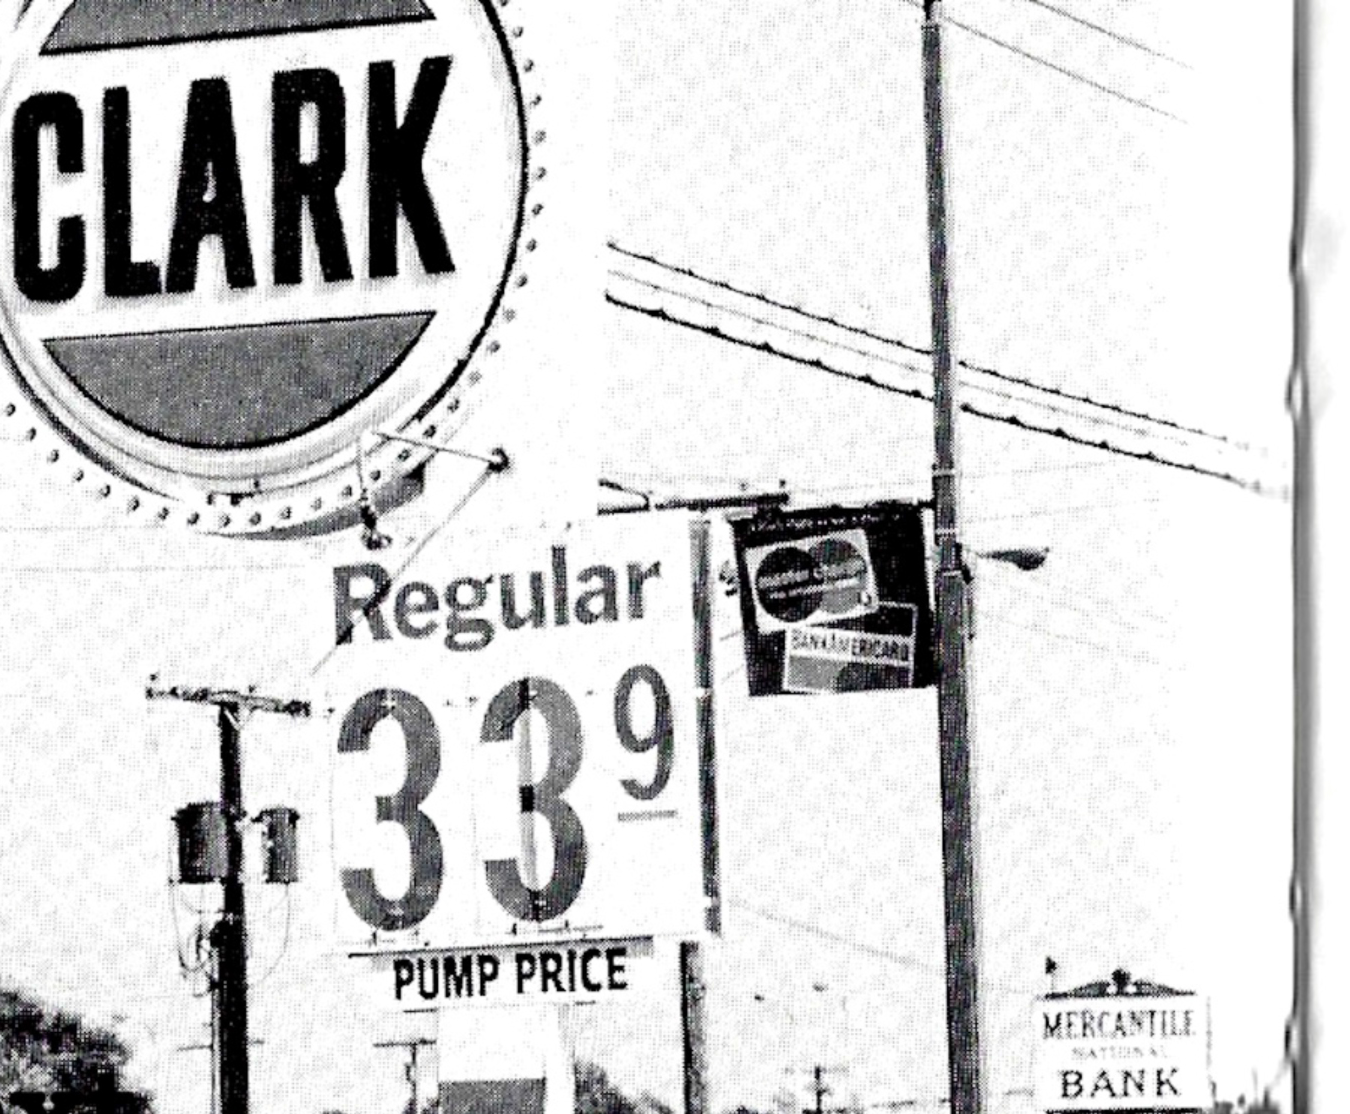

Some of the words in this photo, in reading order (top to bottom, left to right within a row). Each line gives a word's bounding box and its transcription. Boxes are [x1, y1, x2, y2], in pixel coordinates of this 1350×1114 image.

[11, 55, 456, 304] CLARK
[332, 545, 663, 652] Regular
[613, 664, 675, 801] 9
[392, 954, 499, 1000] PUMP
[516, 947, 629, 994] PRICE
[1042, 1009, 1196, 1039] MERCANTILE
[1058, 1066, 1182, 1099] BANK
